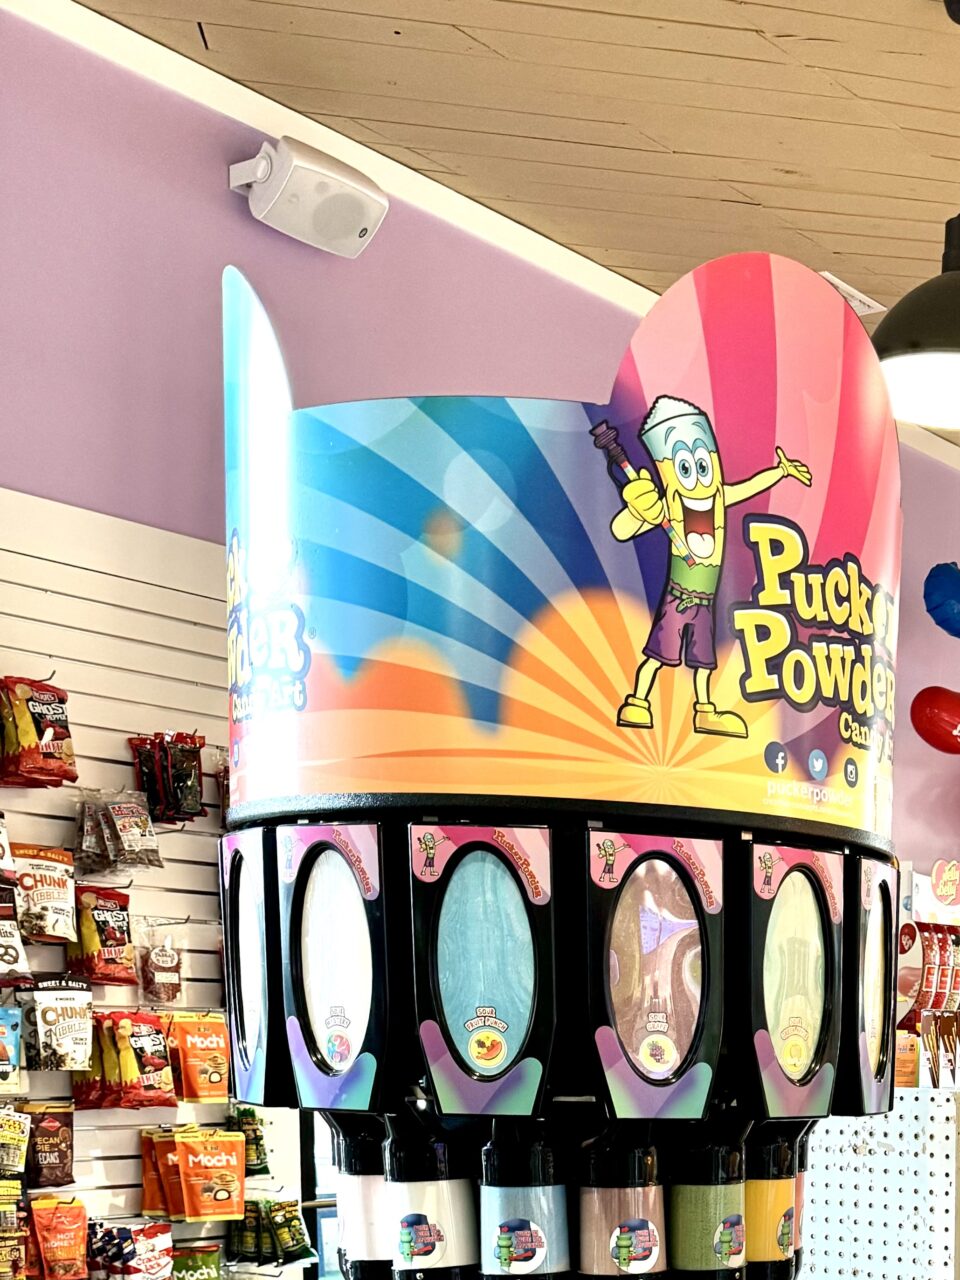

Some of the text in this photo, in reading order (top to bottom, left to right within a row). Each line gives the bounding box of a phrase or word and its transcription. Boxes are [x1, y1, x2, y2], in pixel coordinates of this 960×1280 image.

[28, 701, 68, 715] GHOST
[18, 872, 68, 891] CHUNK
[41, 1006, 89, 1027] CHUNK
[477, 1007, 495, 1017] SOUR
[186, 1034, 225, 1049] Mochi
[188, 1152, 238, 1168] Mochi
